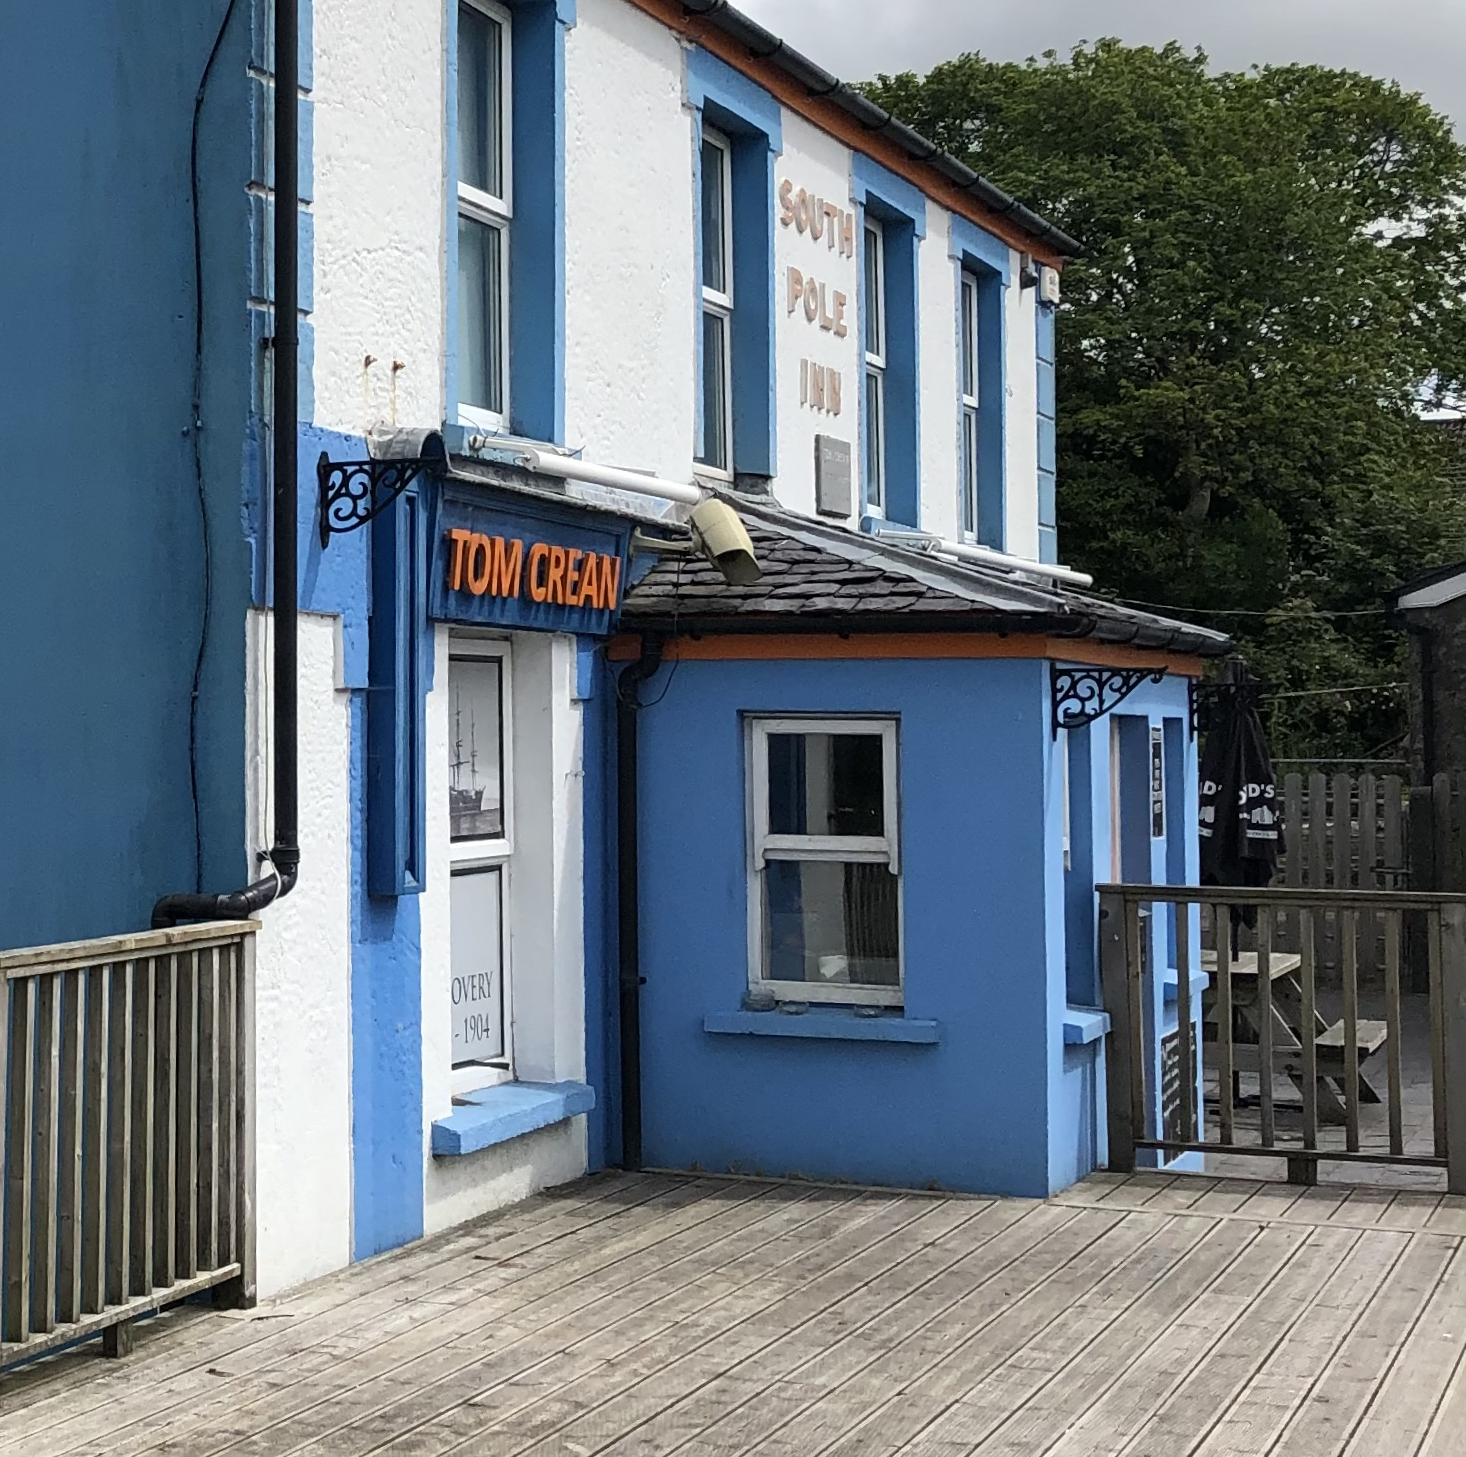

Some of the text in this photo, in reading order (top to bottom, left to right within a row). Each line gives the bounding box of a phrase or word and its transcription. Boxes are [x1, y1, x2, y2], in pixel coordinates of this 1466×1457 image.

[778, 178, 854, 259] SOUTH
[786, 265, 848, 339] POLE
[799, 357, 842, 417] INN
[448, 528, 621, 611] TOM CREAN
[451, 971, 493, 1005] OVERY
[464, 1013, 490, 1043] 1904
